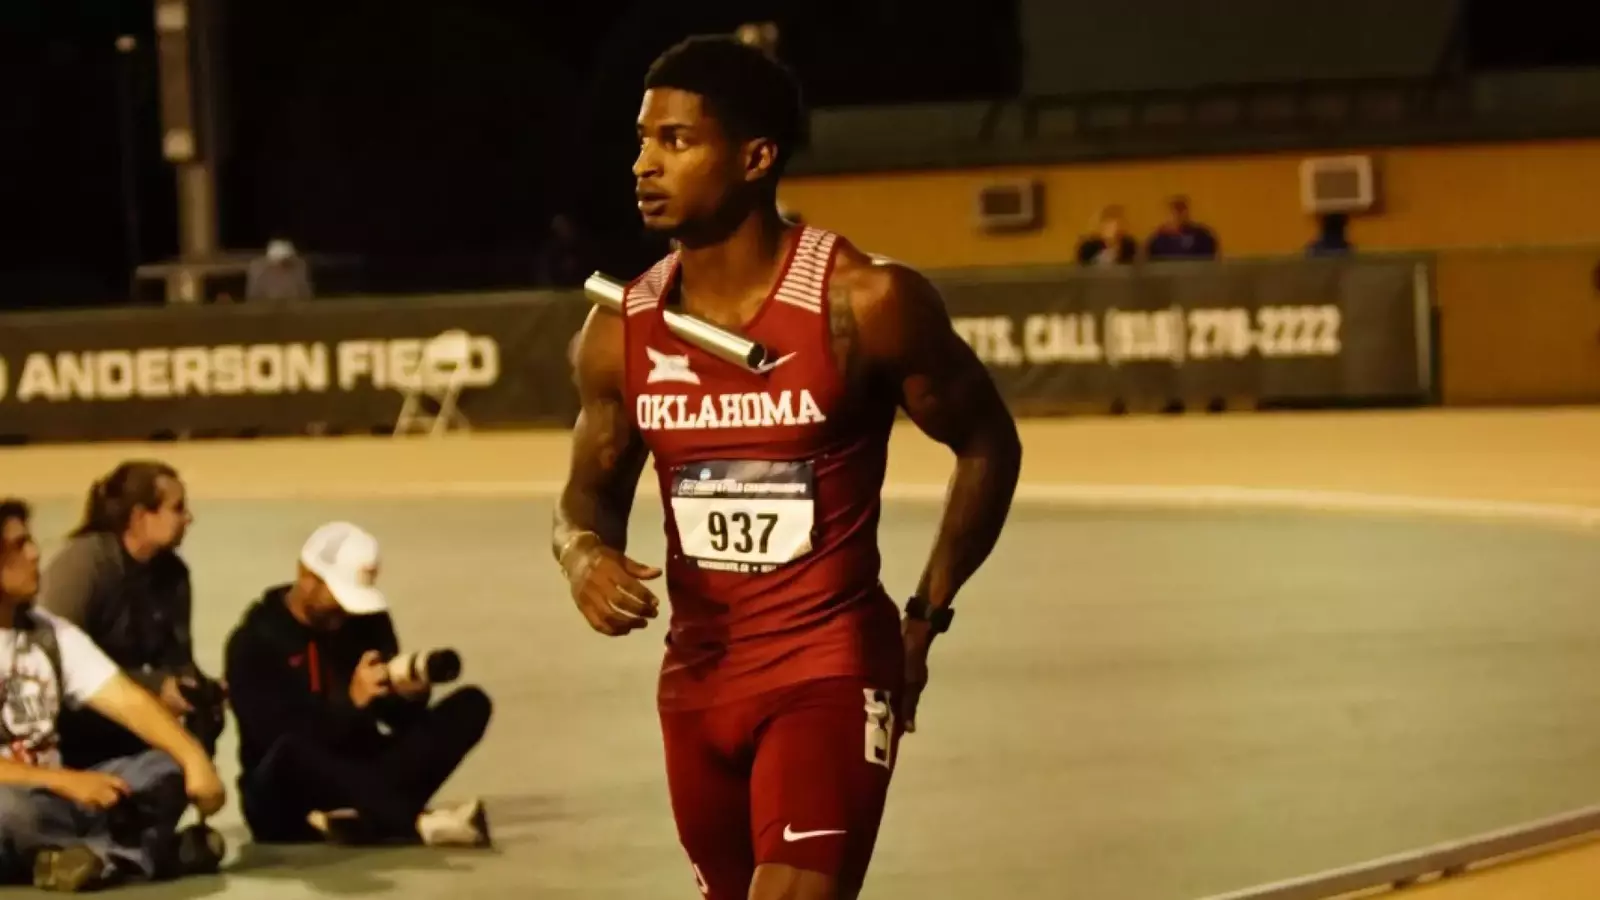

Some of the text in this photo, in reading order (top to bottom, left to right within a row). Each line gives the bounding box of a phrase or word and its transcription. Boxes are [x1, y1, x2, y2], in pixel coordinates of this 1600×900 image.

[1024, 312, 1100, 364] CALL
[15, 341, 326, 402] ANDERSON
[338, 336, 498, 391] FIED
[636, 389, 826, 430] OKLAHOMA
[708, 511, 779, 554] 937
